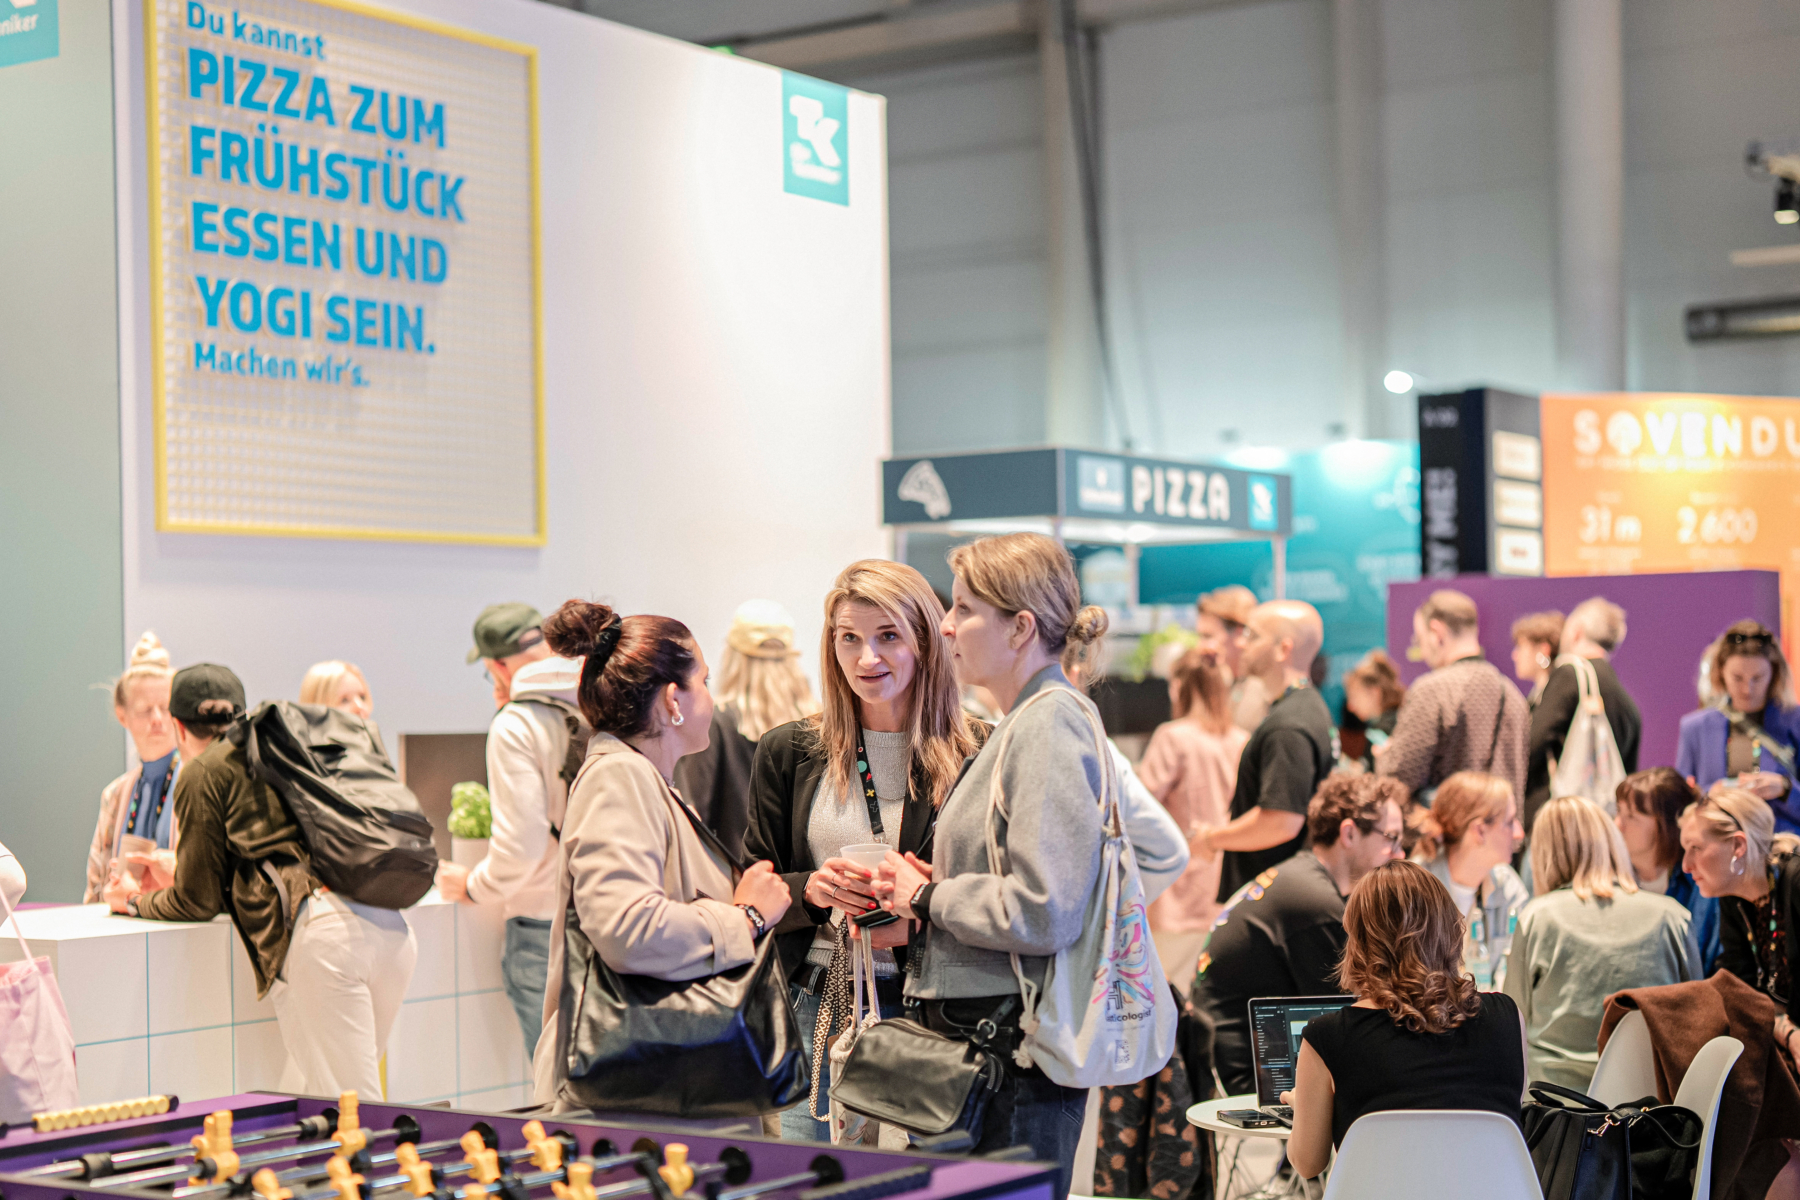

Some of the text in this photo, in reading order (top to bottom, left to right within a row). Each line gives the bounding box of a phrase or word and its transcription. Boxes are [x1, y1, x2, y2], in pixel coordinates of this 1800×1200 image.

[0, 13, 40, 37] niker
[187, 0, 326, 61] Du kannst
[188, 47, 446, 149] PIZZA ZUM
[190, 122, 465, 222] FRÜHSTÜCK
[192, 201, 448, 284] ESSEN UND
[195, 275, 436, 354] YOGI SEIN.
[193, 341, 298, 380] Machen
[1131, 464, 1231, 522] PIZZA
